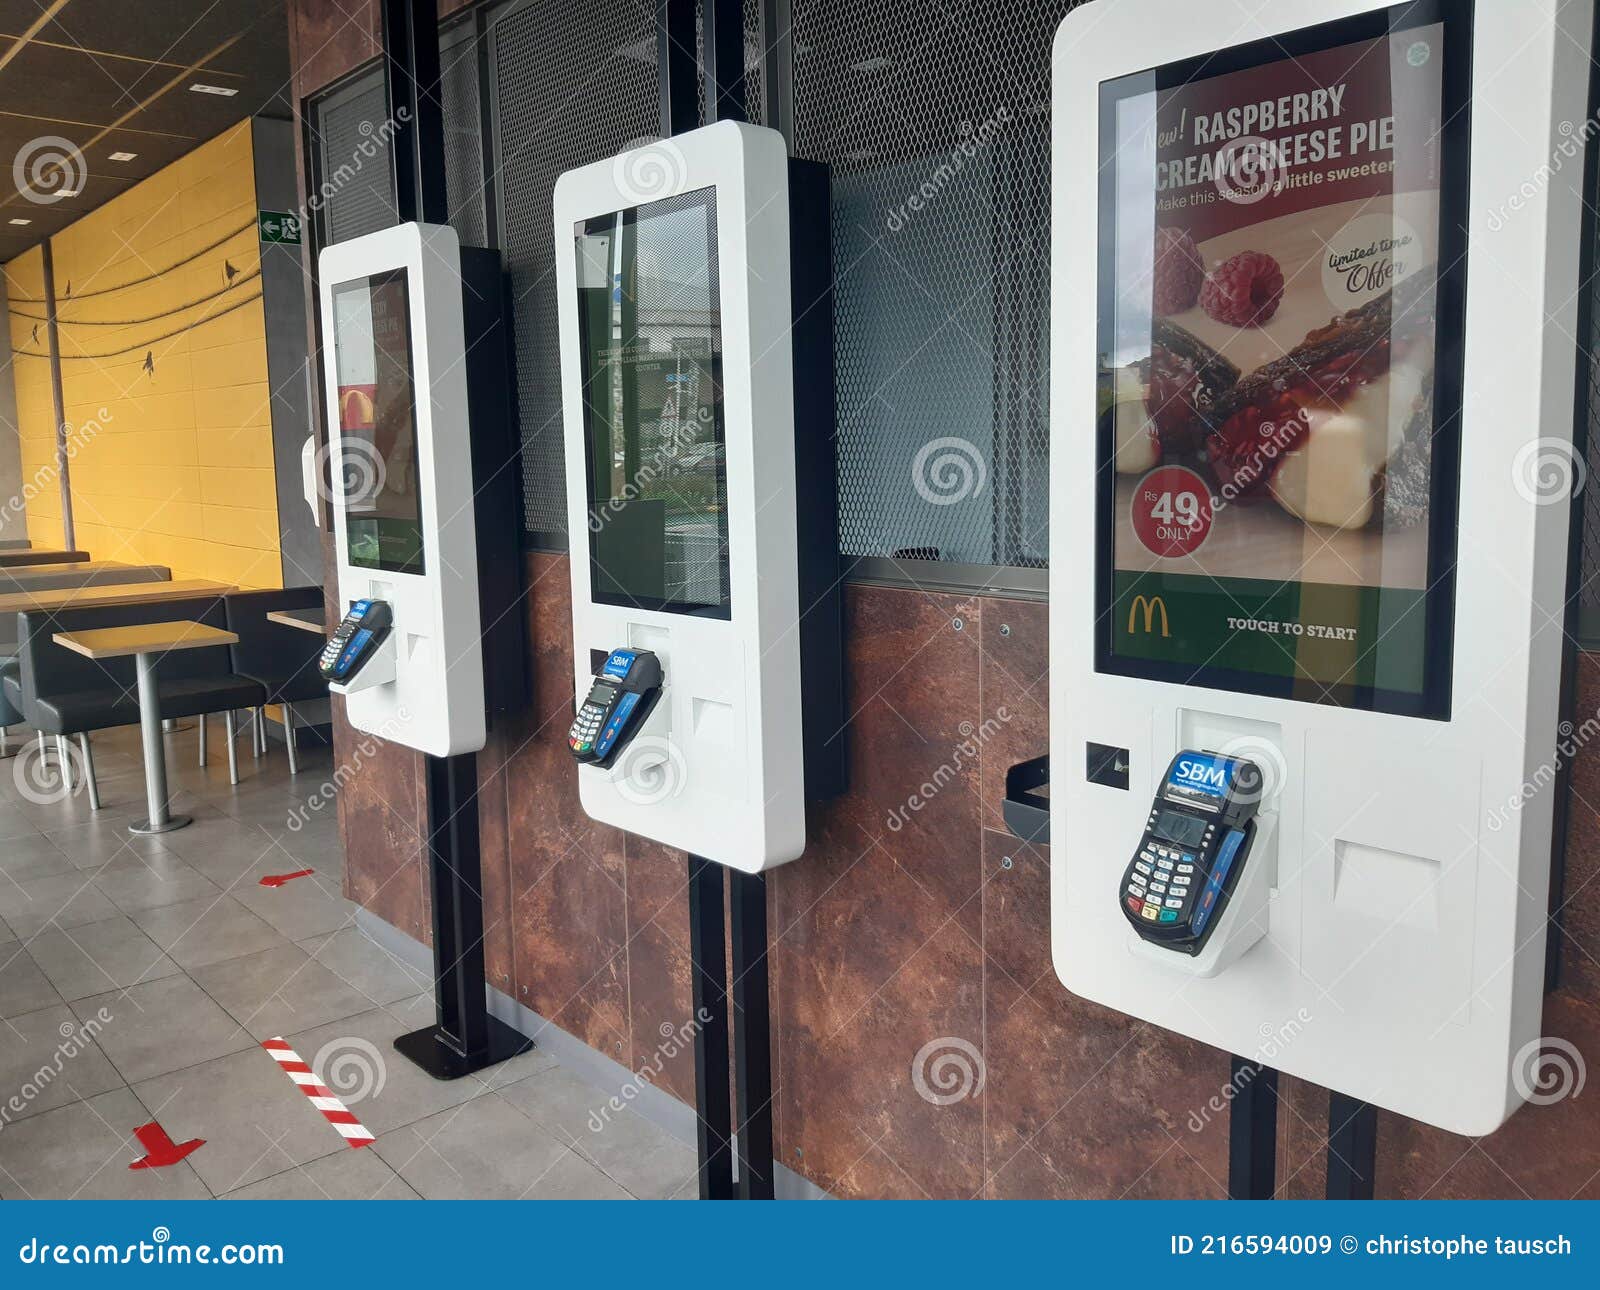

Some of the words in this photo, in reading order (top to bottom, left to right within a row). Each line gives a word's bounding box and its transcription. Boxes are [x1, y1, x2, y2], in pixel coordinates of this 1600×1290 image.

[1194, 83, 1346, 146] RASPBERRY
[1156, 147, 1236, 192] CREAM
[1242, 126, 1342, 175] CHEESE
[1350, 116, 1395, 156] PIE
[1190, 190, 1215, 206] this
[1218, 181, 1270, 201] season
[1272, 178, 1283, 192] a
[1285, 170, 1323, 189] little
[1327, 158, 1396, 183] sweeter
[1329, 242, 1378, 268] limited
[1379, 235, 1412, 252] time
[1336, 258, 1406, 293] Offer
[1144, 490, 1158, 502] Rs
[1151, 491, 1199, 526] 49
[1156, 525, 1193, 541] ONLY
[1227, 616, 1279, 634] TOUCH
[1282, 622, 1304, 636] TO
[1307, 624, 1357, 641] START
[1175, 760, 1226, 787] SBM
